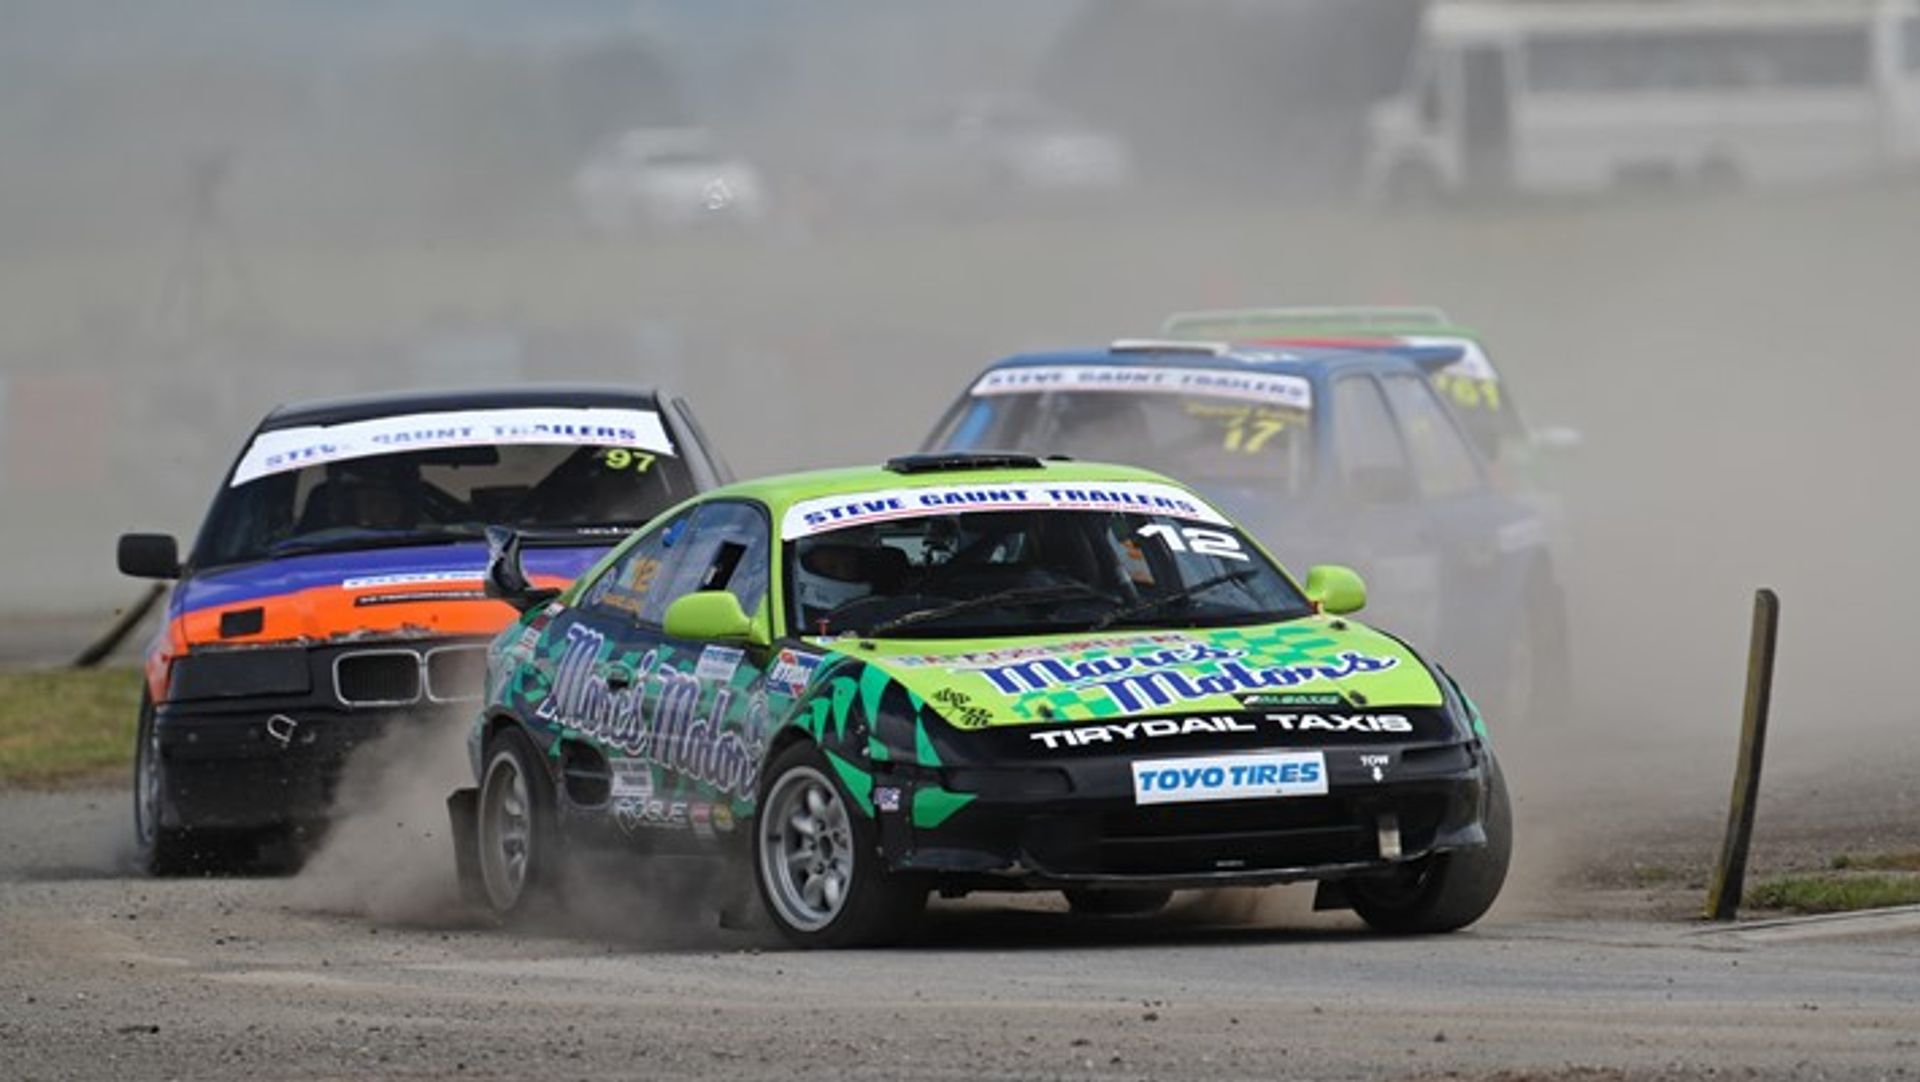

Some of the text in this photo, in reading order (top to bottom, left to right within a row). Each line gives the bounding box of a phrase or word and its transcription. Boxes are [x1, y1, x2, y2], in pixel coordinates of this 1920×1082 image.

[1222, 413, 1284, 453] 17
[605, 449, 656, 472] 97
[803, 497, 906, 526] STEVE
[919, 490, 1028, 505] GAUNT
[1045, 489, 1197, 513] TRAILERS
[1137, 523, 1249, 562] 12
[1102, 651, 1397, 714] Motors
[1030, 714, 1413, 748] TIRYDAIL TAXIS
[1139, 762, 1320, 791] TOYO TIRES
[1360, 755, 1389, 767] TOW
